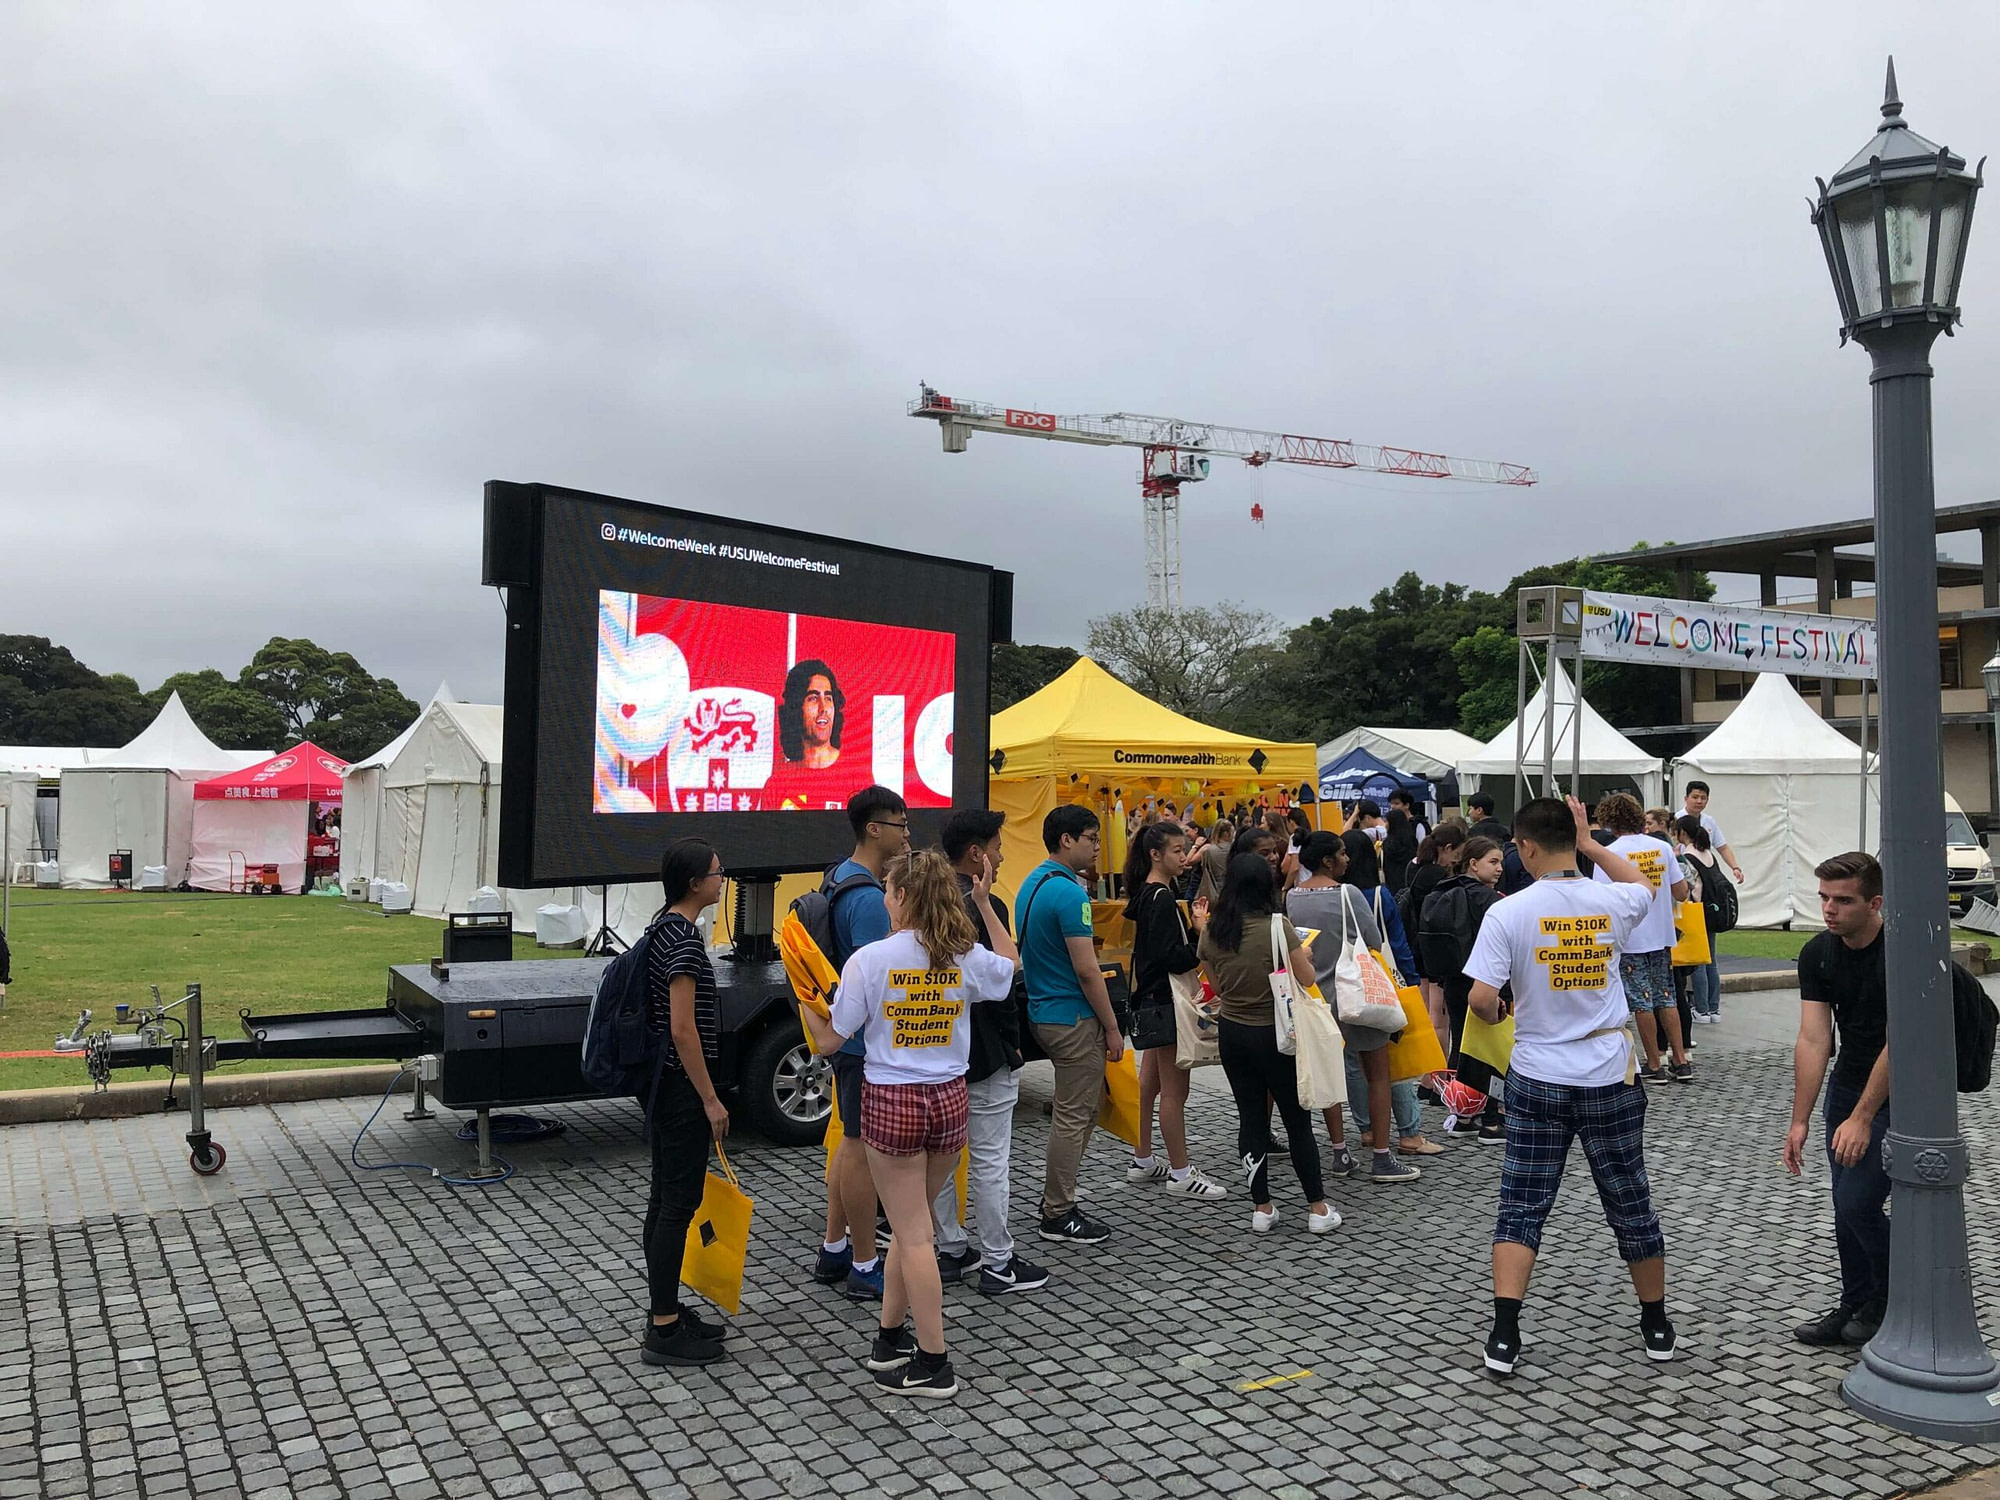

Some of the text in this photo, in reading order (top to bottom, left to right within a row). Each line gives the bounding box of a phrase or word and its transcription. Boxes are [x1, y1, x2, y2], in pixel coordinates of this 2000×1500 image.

[1010, 411, 1051, 428] FDC
[617, 527, 840, 575] #WelcomeWeek #USUWelcomeFestival
[1593, 606, 1612, 617] USU
[1613, 609, 1872, 666] WELCOME FESTIVAL
[1114, 749, 1242, 766] CommonwealthBank
[1543, 918, 1608, 932] Win $10K
[1562, 935, 1593, 946] with
[1538, 947, 1613, 961] CommBank
[1552, 963, 1605, 974] Student
[892, 972, 958, 986] Win $10K
[1553, 976, 1605, 990] Options
[909, 989, 941, 1001] with
[896, 1019, 950, 1031] Student
[895, 1033, 948, 1047] Options
